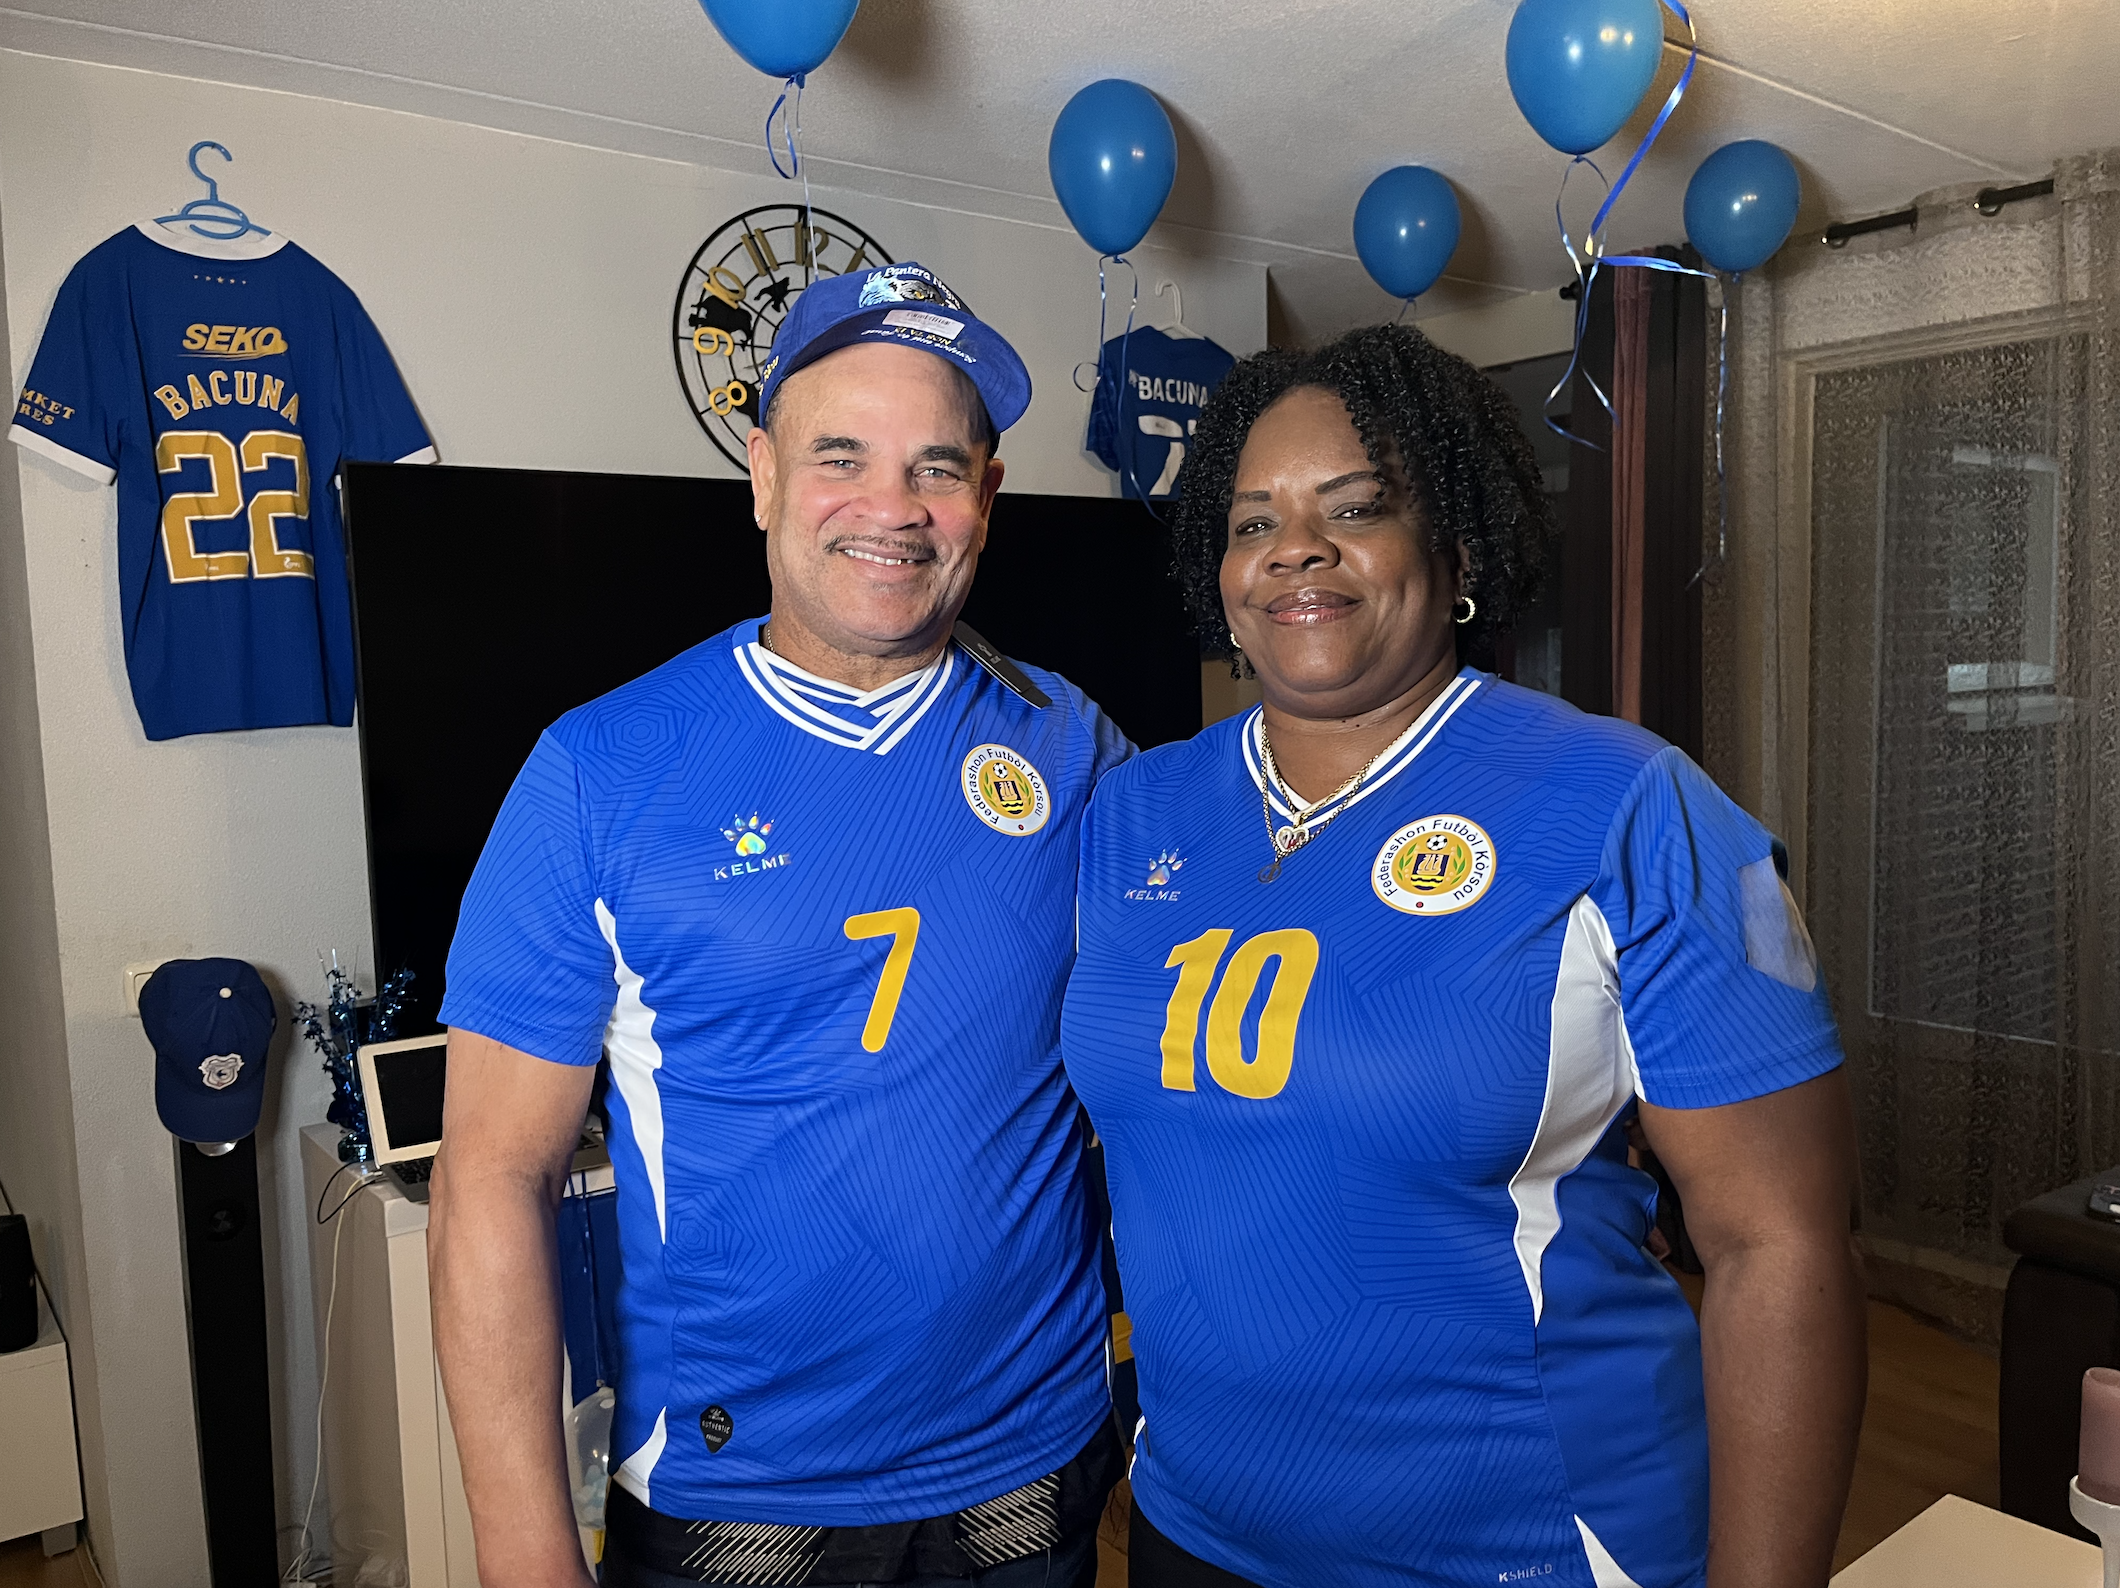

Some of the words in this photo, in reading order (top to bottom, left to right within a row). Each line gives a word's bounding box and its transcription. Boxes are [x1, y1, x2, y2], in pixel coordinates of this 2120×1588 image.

[741, 227, 780, 277] 11
[794, 221, 830, 272] 12
[703, 266, 746, 310] 10
[885, 265, 931, 281] Pantera
[182, 323, 288, 354] SEKO
[693, 326, 734, 357] 9
[22, 388, 75, 419] MKET
[154, 370, 299, 426] BACUNA
[708, 380, 748, 416] 8
[1138, 376, 1208, 408] BACUNA
[19, 402, 55, 426] RES
[156, 430, 315, 584] 22
[968, 754, 999, 825] Federashon
[714, 853, 791, 880] KELME
[1377, 825, 1426, 897] Federashon
[1124, 889, 1181, 901] KELME
[843, 907, 920, 1053] 7
[1160, 928, 1319, 1099] 10
